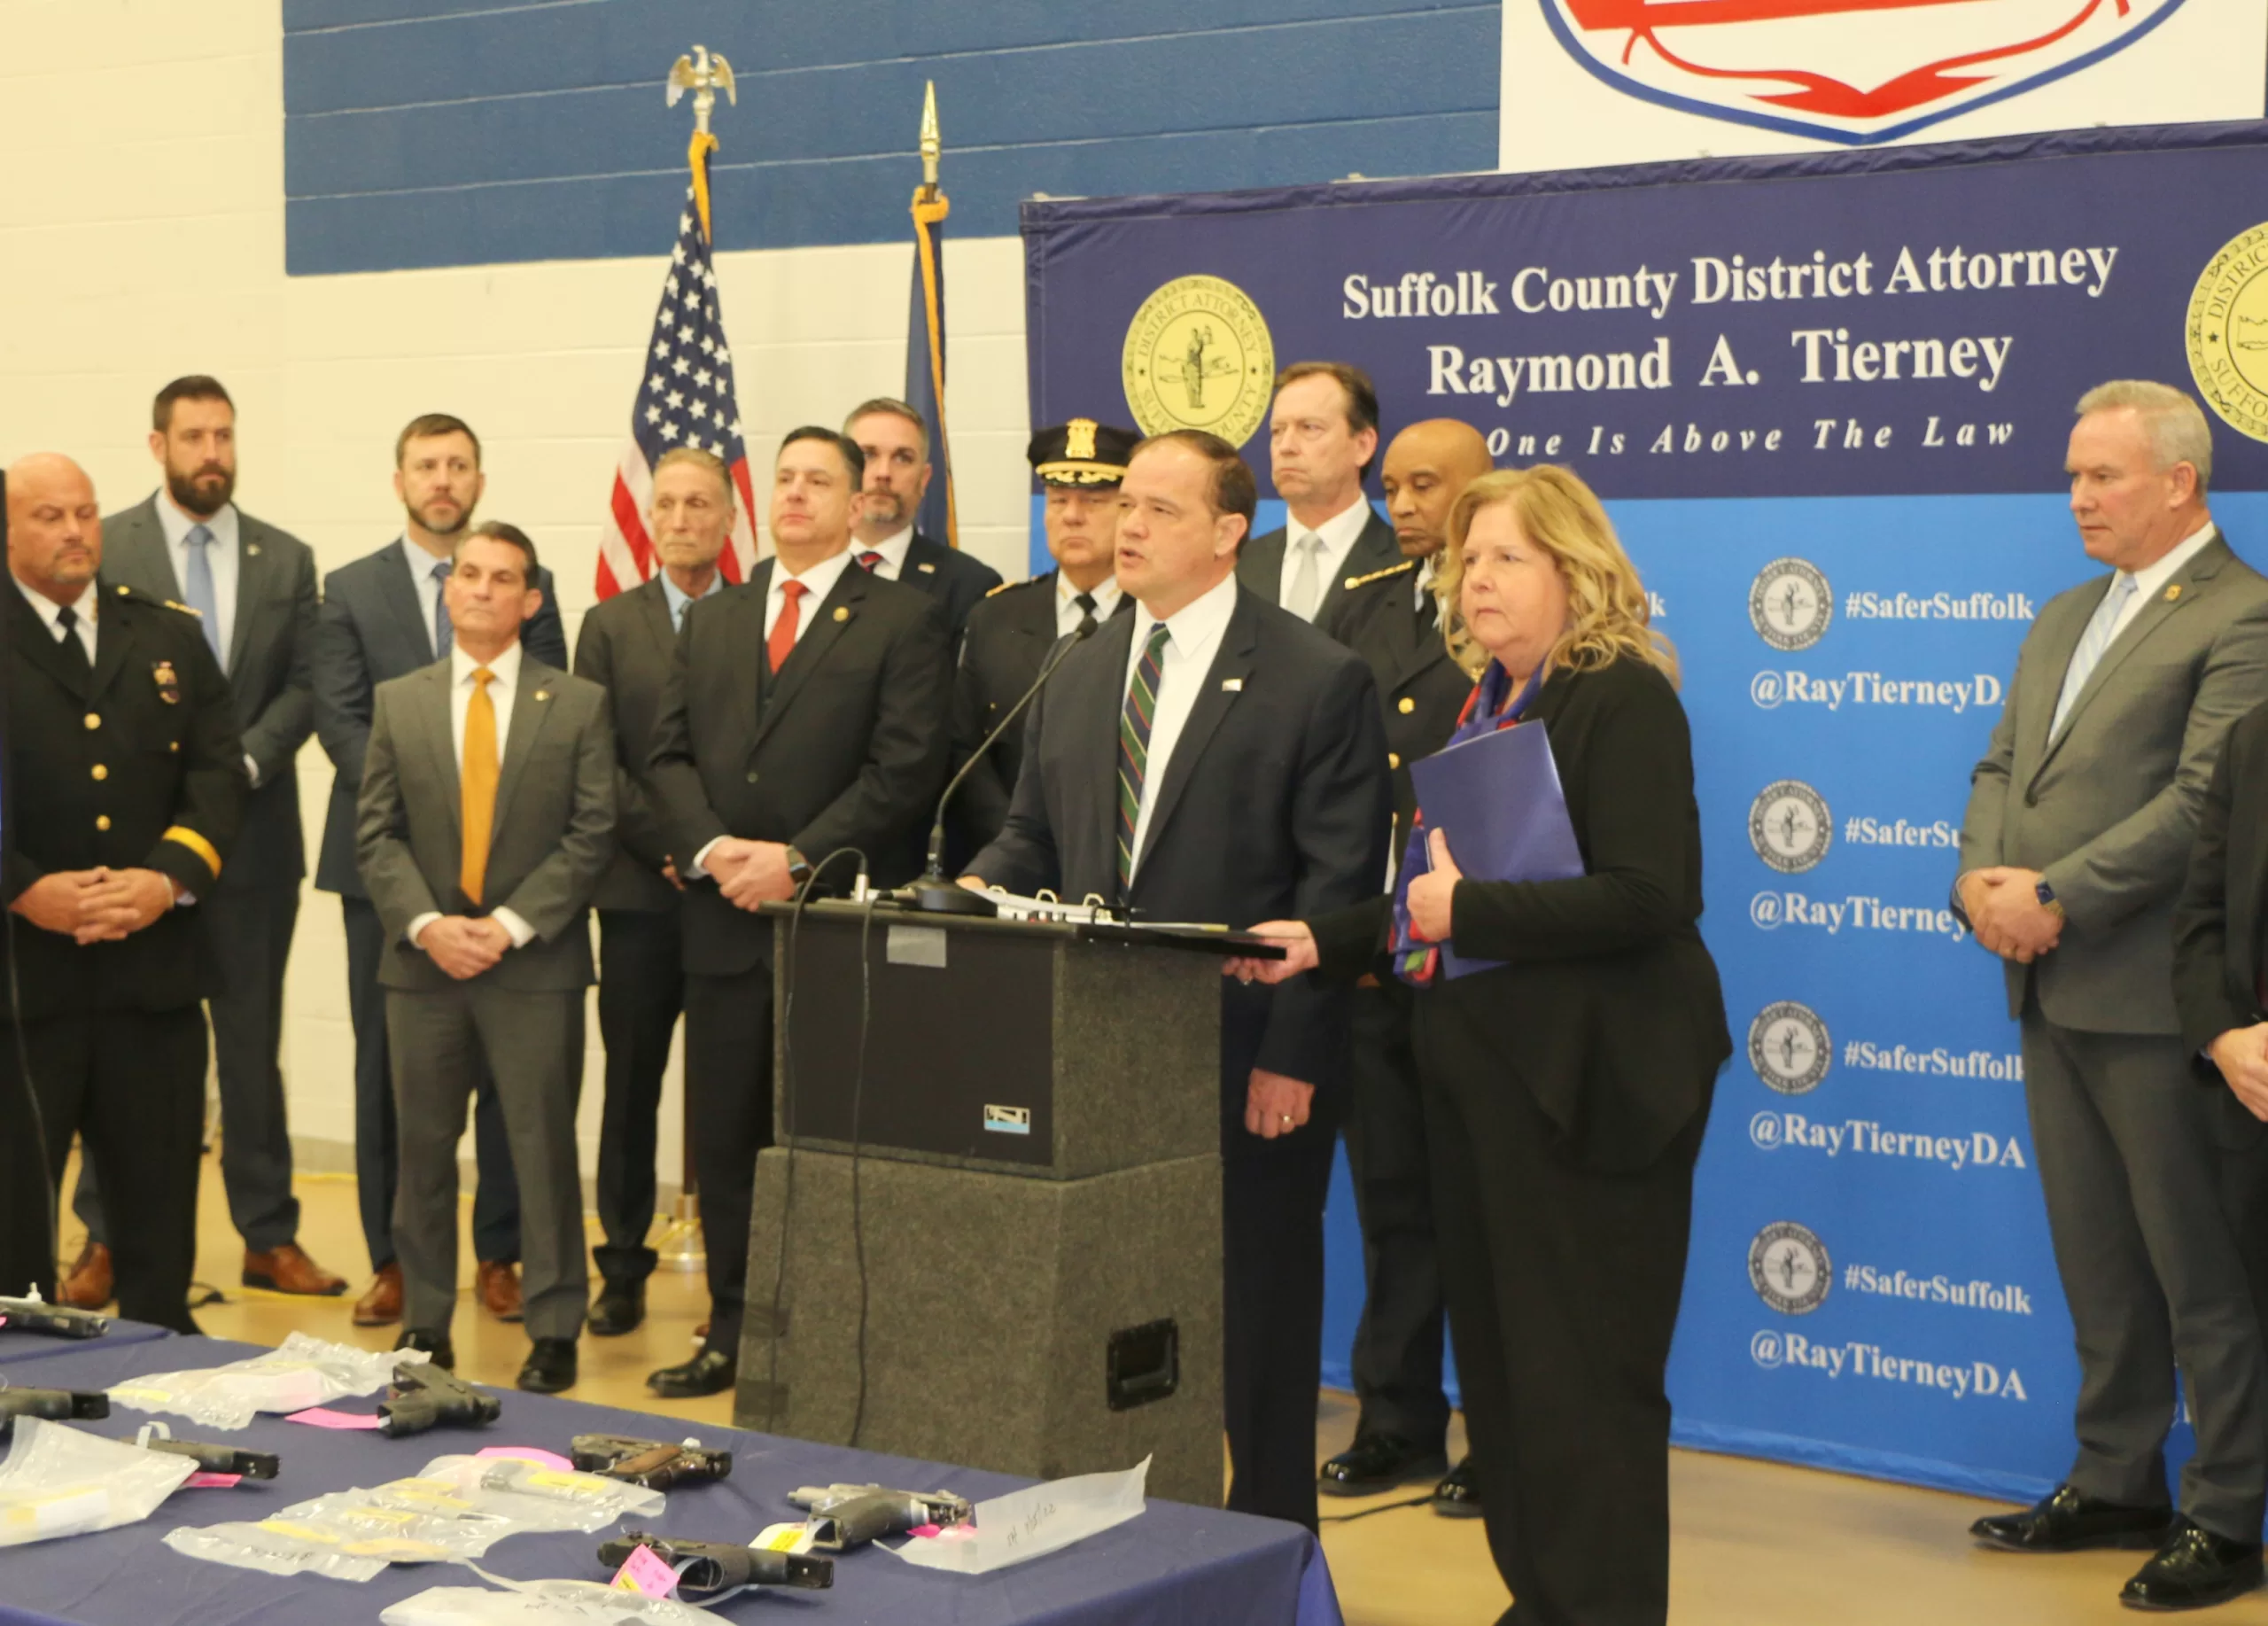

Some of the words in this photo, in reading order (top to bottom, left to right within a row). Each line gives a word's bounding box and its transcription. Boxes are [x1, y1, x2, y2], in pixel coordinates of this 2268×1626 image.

[1342, 269, 1500, 319] Suffolk
[1510, 264, 1678, 321] County
[1689, 249, 1873, 305] District
[1883, 244, 2118, 298] Attorney
[2207, 244, 2268, 319] DISTRIC
[1139, 294, 1188, 358] DISTRICT
[1192, 292, 1259, 354] ATTORNEY
[1425, 335, 1673, 408] Raymond
[1697, 333, 1760, 388] A.
[1790, 326, 2014, 393] Tierney
[2212, 357, 2268, 418] SUFFO
[1486, 426, 1563, 457] One
[1586, 424, 1626, 455] Is
[1649, 423, 1783, 454] Above
[1813, 418, 1893, 450] The
[1921, 415, 2015, 447] Law
[1845, 590, 2036, 621] #SaferSuffolk
[1750, 669, 2007, 713] @RayTierneyD
[1750, 891, 1967, 942] @RayTierney
[1749, 1111, 2026, 1170] @RayTierneyDA
[1845, 1264, 2032, 1314] #SaferSuffolk
[1750, 1330, 2028, 1401] @RayTierneyDA
